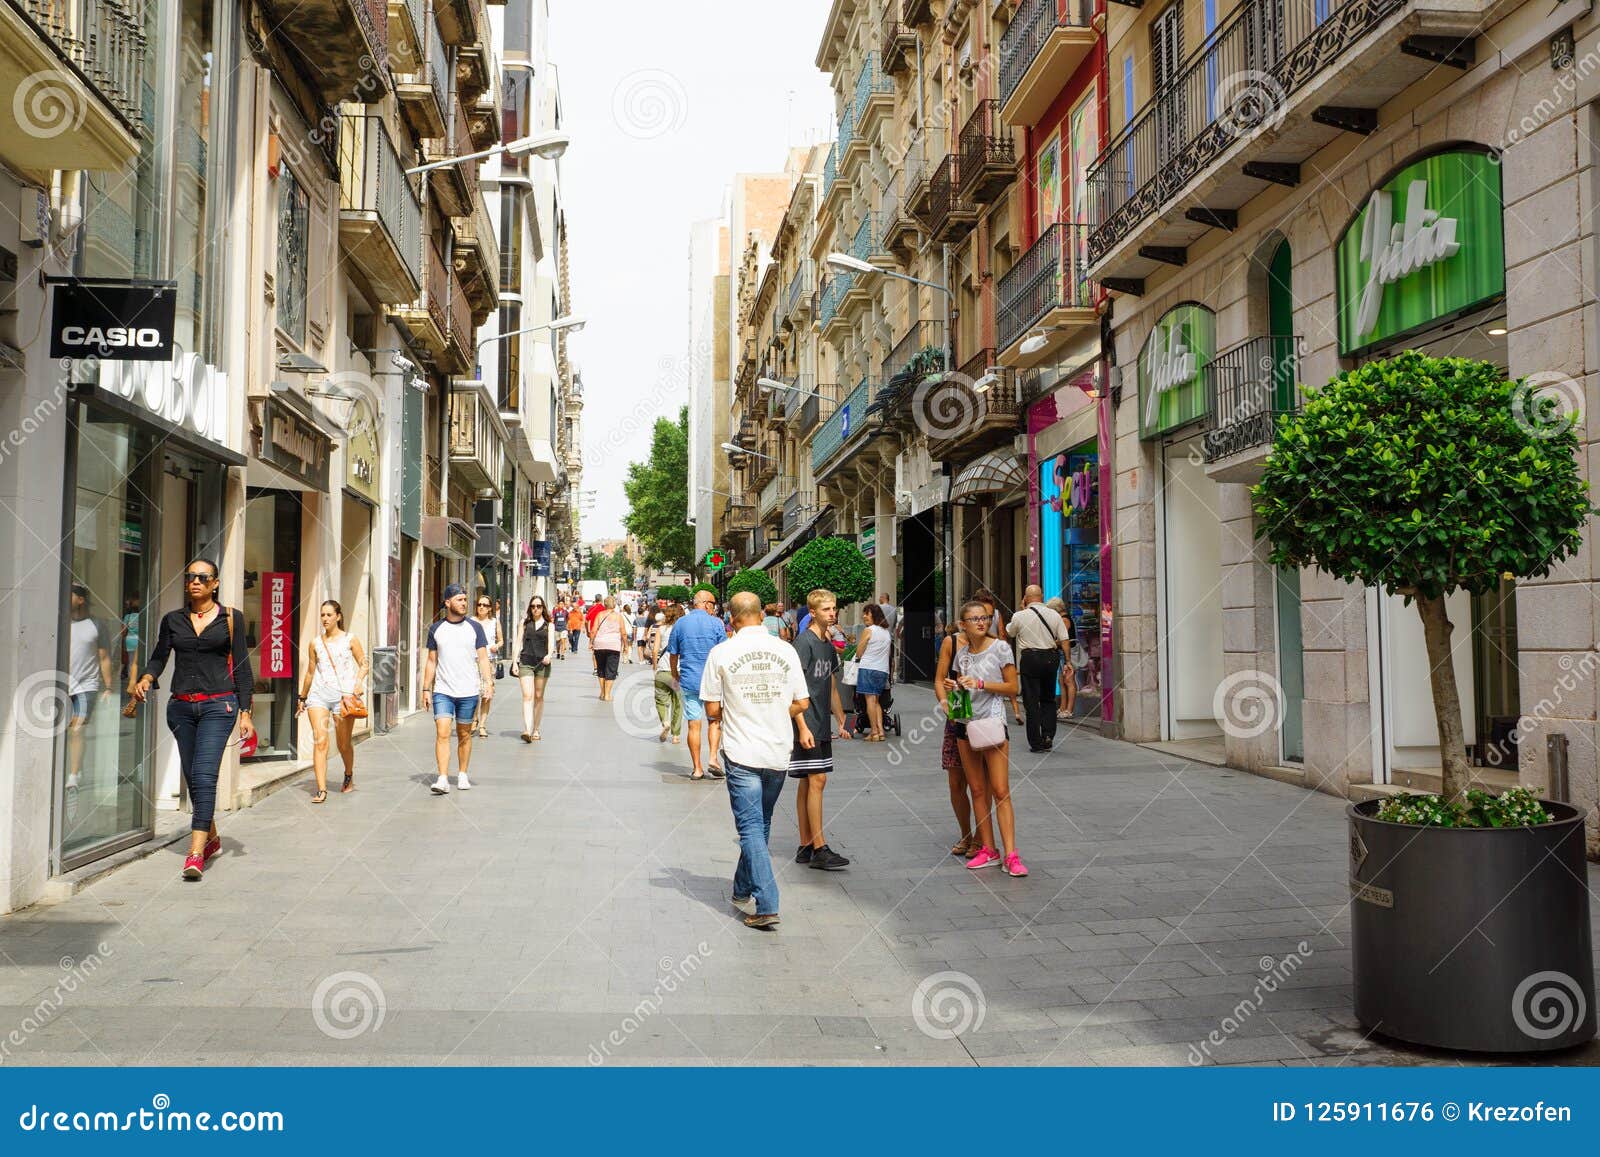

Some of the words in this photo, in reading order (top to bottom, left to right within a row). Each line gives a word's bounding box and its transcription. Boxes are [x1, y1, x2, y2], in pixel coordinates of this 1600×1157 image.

[271, 578, 284, 673] REBAIXES
[728, 650, 792, 674] CLYDESTOWN
[752, 662, 771, 671] HIGH
